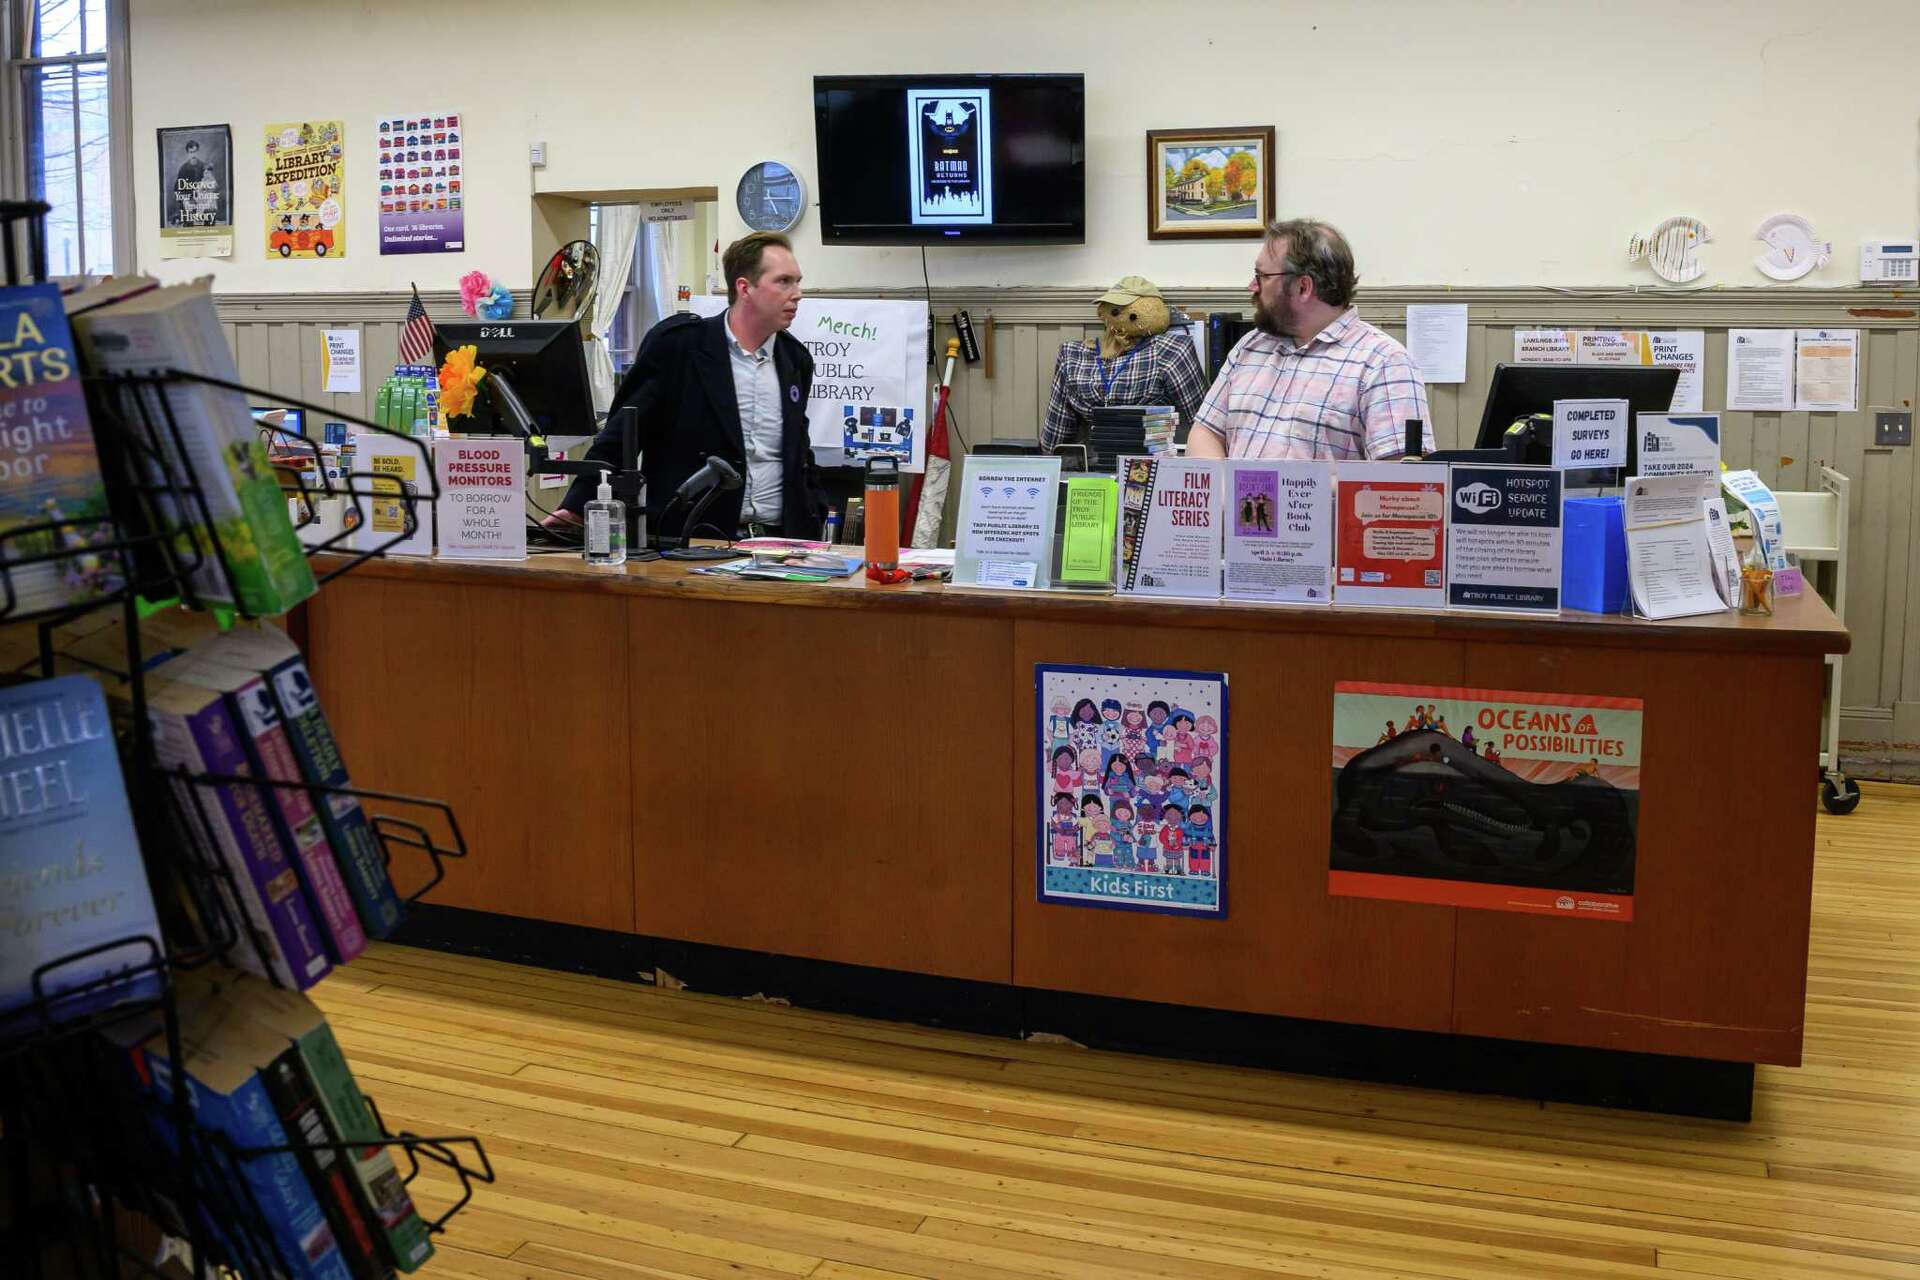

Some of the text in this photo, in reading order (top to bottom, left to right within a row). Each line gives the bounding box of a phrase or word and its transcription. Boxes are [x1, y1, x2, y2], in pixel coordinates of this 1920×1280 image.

[276, 151, 327, 171] LIBRARY
[934, 161, 967, 171] BATMAN
[266, 163, 336, 186] EXPEDITION
[178, 178, 217, 190] Discover
[174, 192, 192, 201] Your
[180, 209, 216, 224] History
[480, 327, 515, 337] DELL
[817, 316, 878, 340] Merch!
[801, 341, 851, 356] TROY
[814, 363, 865, 378] UBLIC
[23, 397, 47, 415] to
[1567, 410, 1615, 421] COMPLETED
[1572, 429, 1610, 441] SURVEYS
[458, 450, 500, 459] BLOOD
[1571, 449, 1610, 460] GO HERE!
[382, 465, 404, 473] HEARD.
[449, 464, 511, 472] PRESSURE
[448, 476, 512, 486] MONITORS
[1184, 472, 1210, 489] FILM
[1282, 478, 1318, 489] Happily
[1506, 478, 1550, 488] HOTSPOT
[449, 494, 512, 503] TO BORROW
[1158, 491, 1210, 508] LITERACY
[1288, 490, 1312, 498] Ever
[1508, 493, 1547, 504] SERVICE
[466, 506, 495, 515] FOR A
[1288, 501, 1313, 509] After
[1287, 512, 1312, 521] Book
[1508, 508, 1547, 518] UPDATE
[463, 518, 500, 528] WHOLE
[1171, 510, 1210, 528] SERIES
[1288, 524, 1311, 532] Club
[462, 531, 502, 539] MONTH!
[1515, 592, 1544, 601] LIBRARY
[1478, 708, 1592, 733] OCEANS OF
[1503, 733, 1624, 757] POSSIBILITIES
[1090, 874, 1174, 899] Kids First
